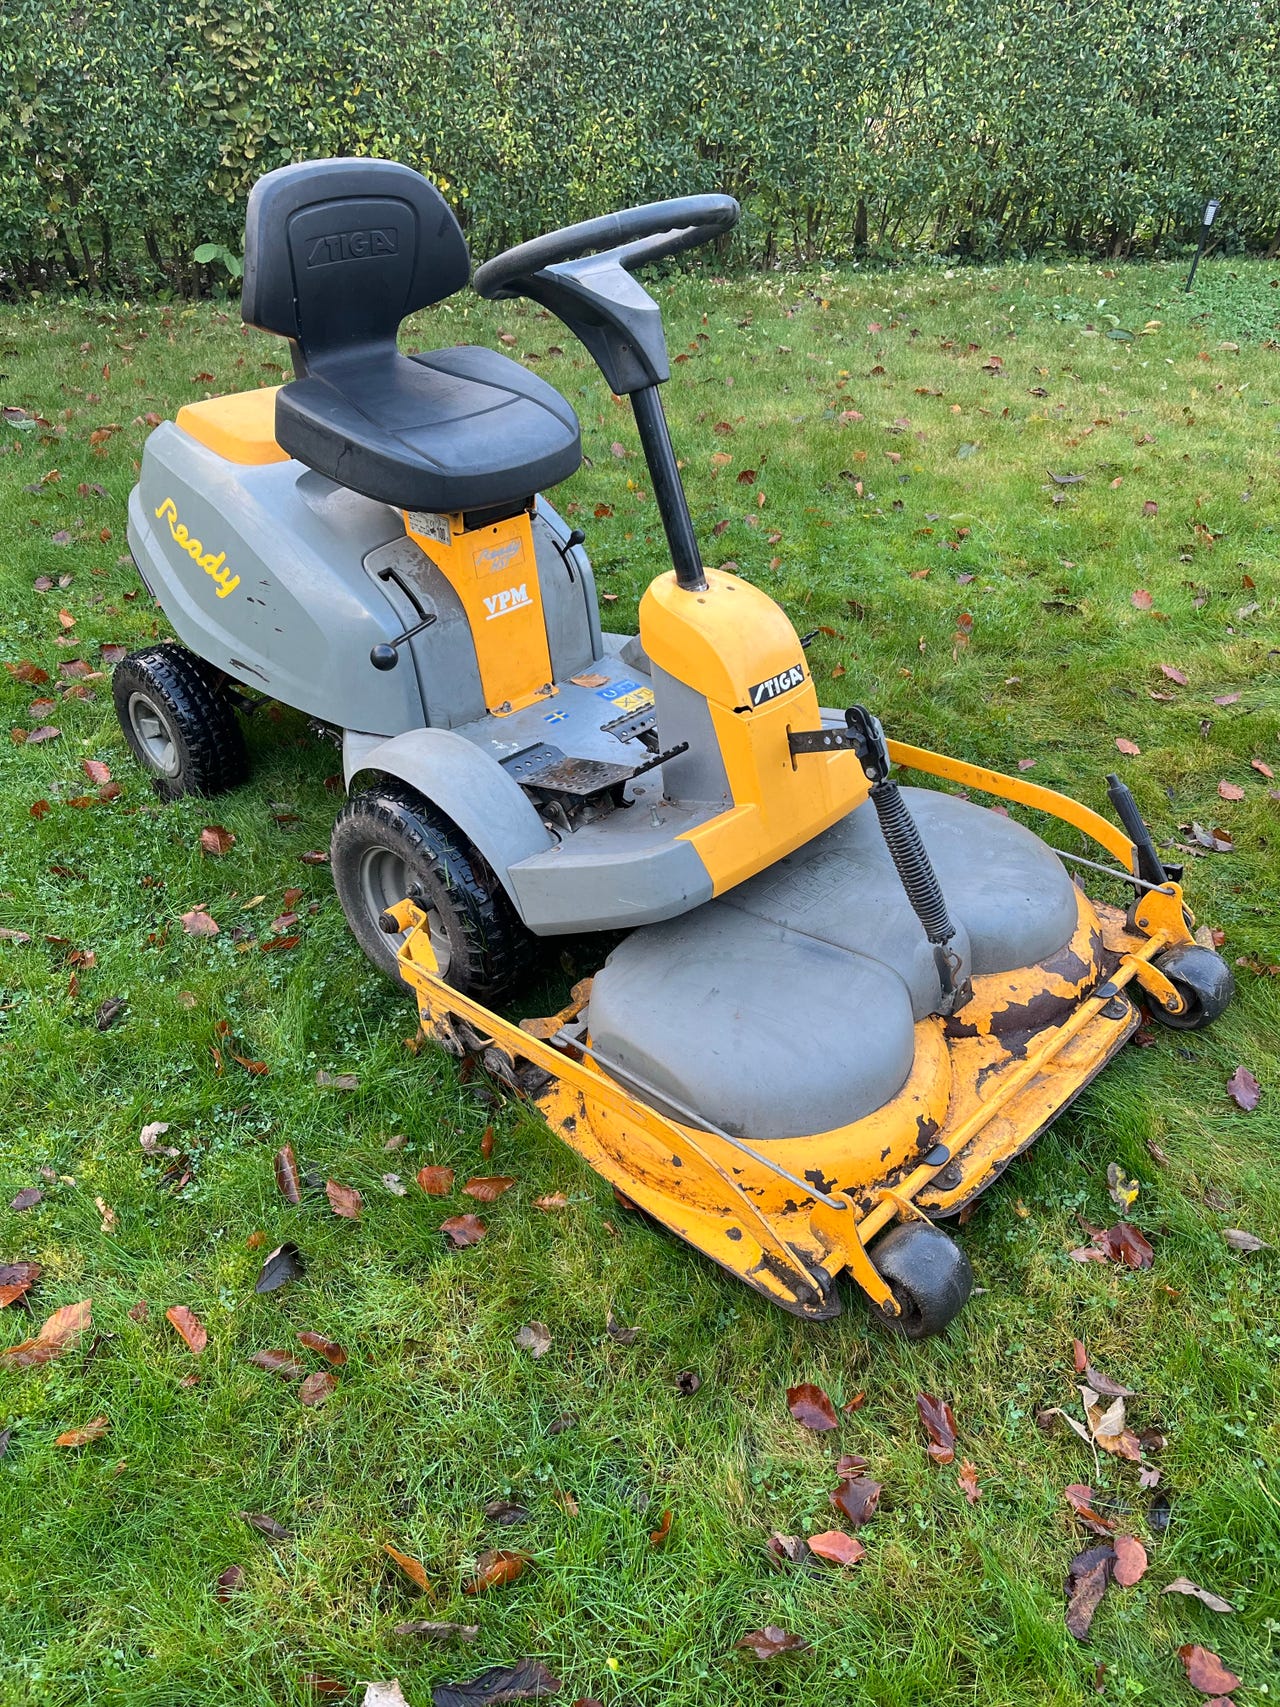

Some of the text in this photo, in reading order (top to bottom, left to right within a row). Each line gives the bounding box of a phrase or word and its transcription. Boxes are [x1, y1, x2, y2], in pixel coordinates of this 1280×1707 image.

[308, 231, 395, 267] STIGA
[155, 497, 241, 599] Ready
[482, 583, 528, 614] VPM
[754, 668, 804, 705] STIGA
